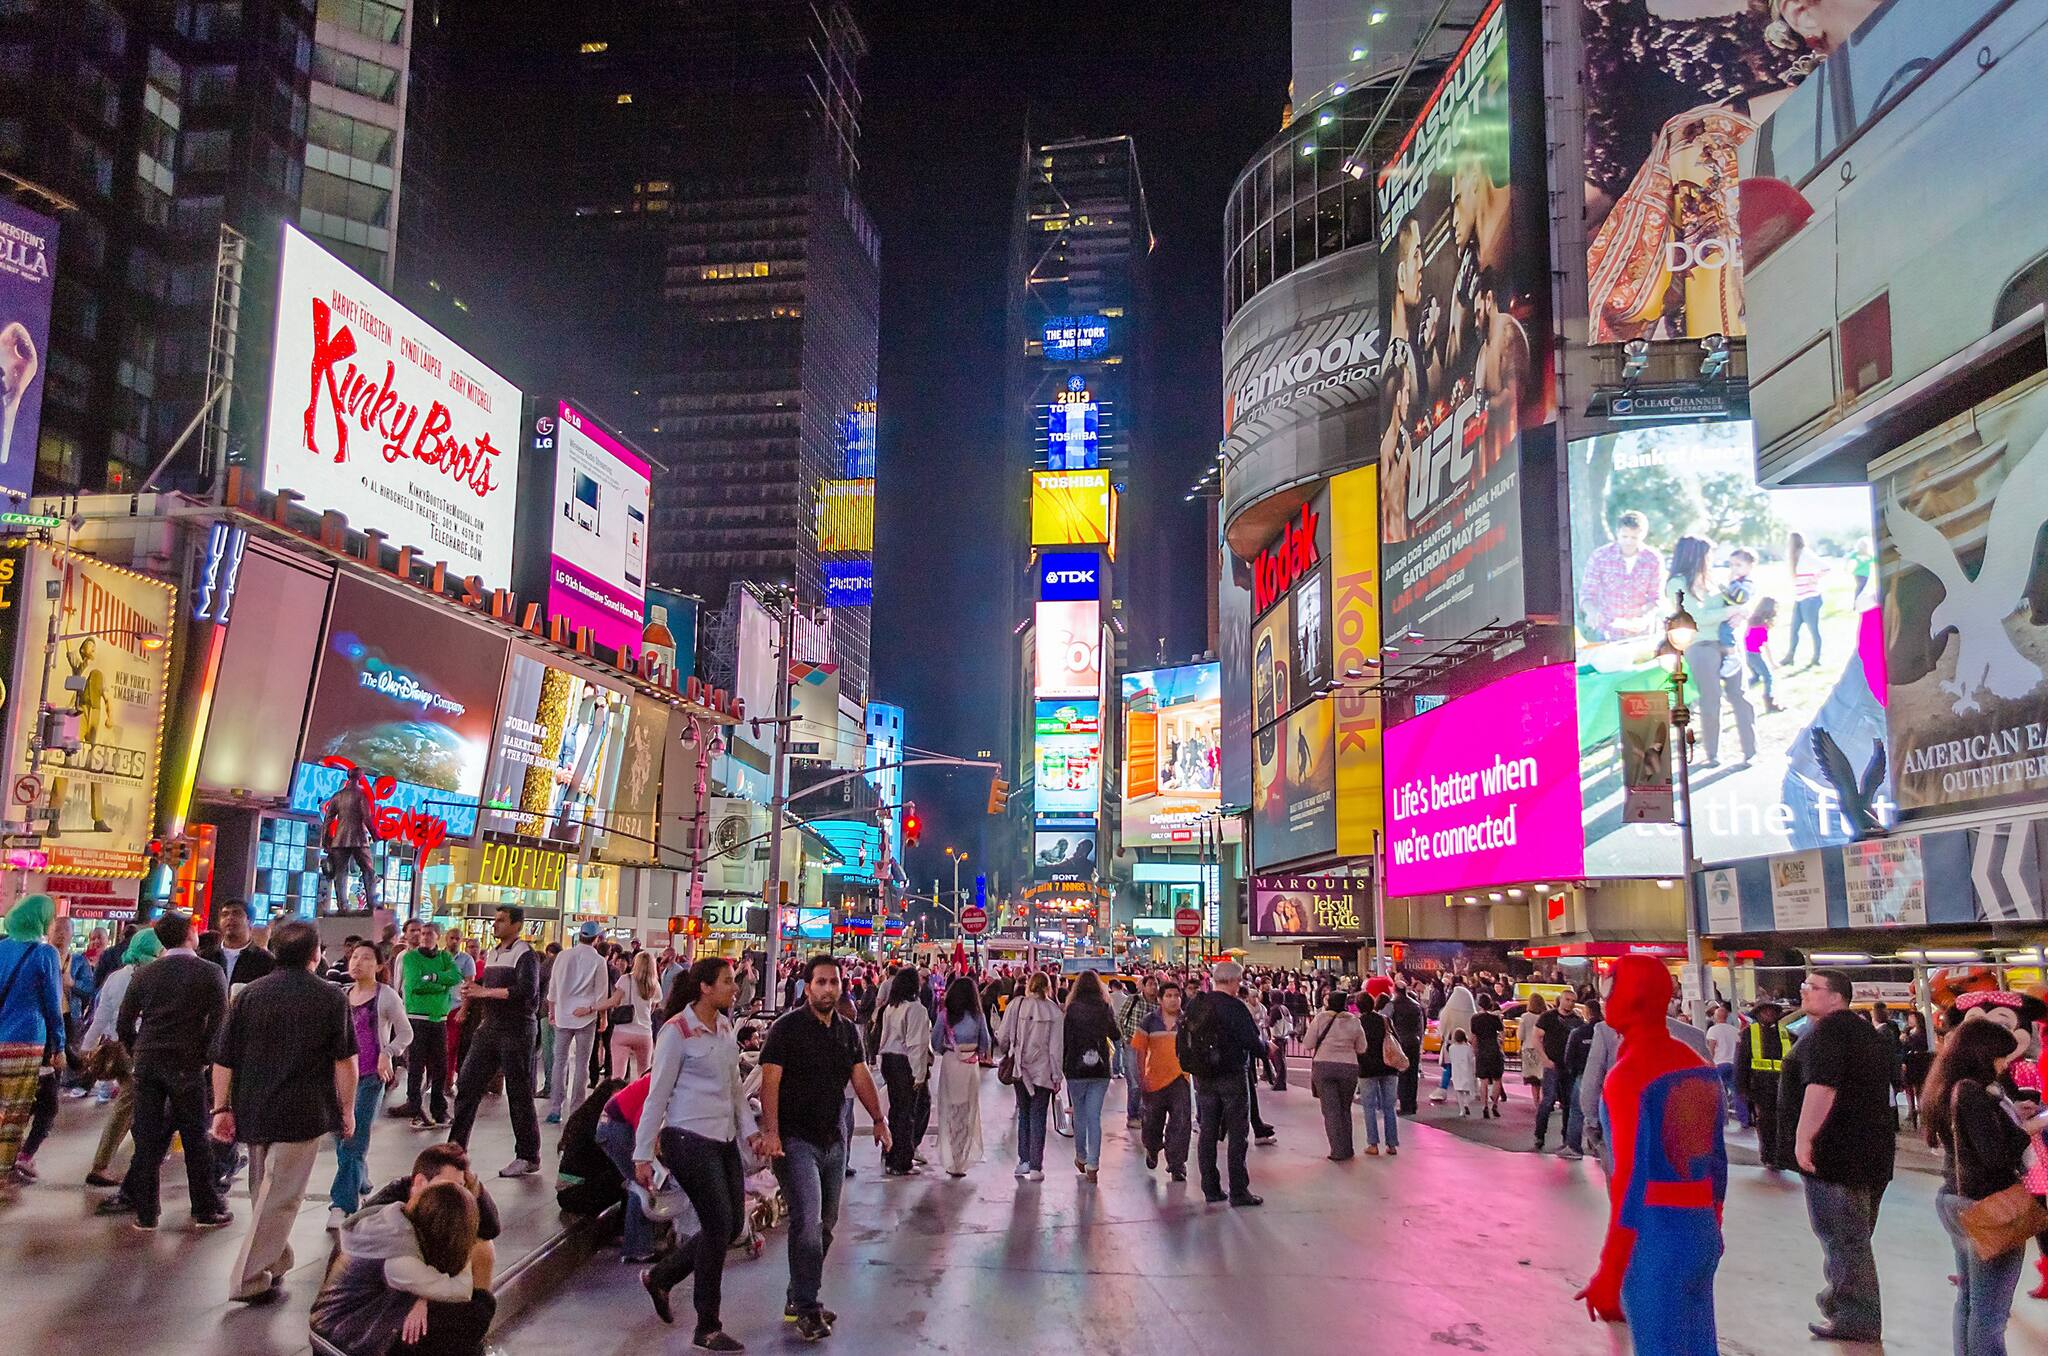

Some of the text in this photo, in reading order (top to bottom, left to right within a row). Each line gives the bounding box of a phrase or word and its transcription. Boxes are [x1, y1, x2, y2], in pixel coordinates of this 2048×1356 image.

[1379, 4, 1503, 214] VELASQUEZ
[1392, 75, 1484, 238] BIGFOOT
[332, 289, 492, 414] HARVEY FIERSTEIN CYNDI LAUPER JERRY MITCHELL
[1046, 330, 1061, 340] THE
[1083, 327, 1105, 338] YORK
[303, 297, 502, 497] Kinky Boots
[1057, 391, 1090, 404] 2013
[1247, 365, 1380, 424] driving emotion
[536, 438, 552, 448] LG
[572, 414, 581, 429] LG
[1049, 431, 1097, 442] TOSHIBA
[1408, 395, 1477, 520] UFC
[1038, 475, 1105, 489] TOSHIBA
[1464, 495, 1489, 520] MARK
[1491, 472, 1516, 501] HUNT
[6, 514, 56, 527] LAMAR
[371, 480, 378, 494] AL
[380, 484, 414, 511] HIRSCHFELD
[461, 527, 475, 542] 45TH
[1254, 502, 1320, 616] Kodak
[1403, 540, 1451, 589] SATURDAY
[1452, 522, 1474, 554] MAY
[1475, 512, 1491, 538] 25
[1408, 544, 1422, 563] DOS
[1423, 521, 1452, 552] SANTOS
[556, 569, 564, 584] LG
[578, 581, 604, 603] Immersive
[604, 594, 619, 612] Sound
[619, 602, 634, 619] Home
[1057, 570, 1095, 583] TDK
[115, 671, 129, 686] NEW
[1336, 570, 1376, 756] Kodak
[363, 672, 377, 687] The
[378, 671, 400, 697] Walt
[399, 676, 432, 710] Disney
[502, 735, 542, 753] MARKETING
[505, 715, 541, 738] JORDAN
[1903, 727, 2020, 774] AMERICAN
[1393, 754, 1538, 821] Life's better when
[1393, 803, 1517, 865] we're connected
[1704, 791, 1795, 836] the
[480, 842, 566, 891] FOREVER
[1256, 879, 1365, 890] MARQUIS
[75, 908, 136, 919] Canon SONY
[1313, 894, 1353, 914] Jekyll
[1318, 910, 1360, 930] Hyde
